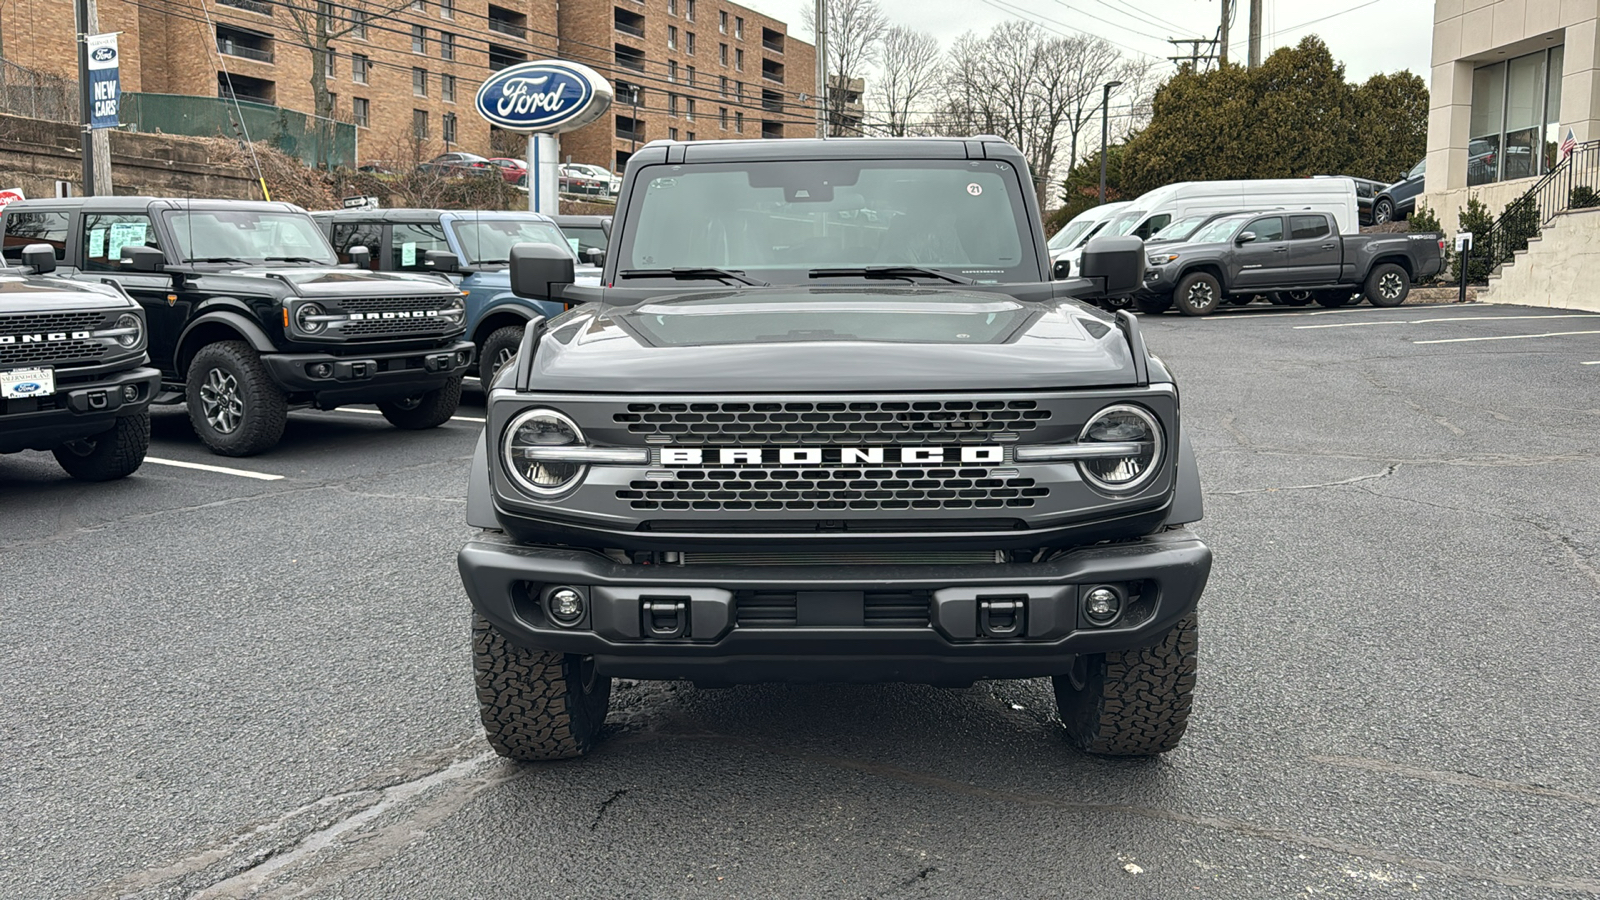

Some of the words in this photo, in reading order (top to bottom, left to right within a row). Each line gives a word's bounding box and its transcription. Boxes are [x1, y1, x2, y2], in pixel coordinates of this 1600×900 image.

[95, 48, 112, 61] Ford
[94, 80, 117, 101] NEW
[497, 75, 566, 117] Ford
[95, 99, 117, 117] CARS
[970, 185, 980, 194] 21
[350, 310, 438, 320] BRONCO
[18, 383, 36, 392] Ford
[660, 446, 1004, 465] BRONCO
